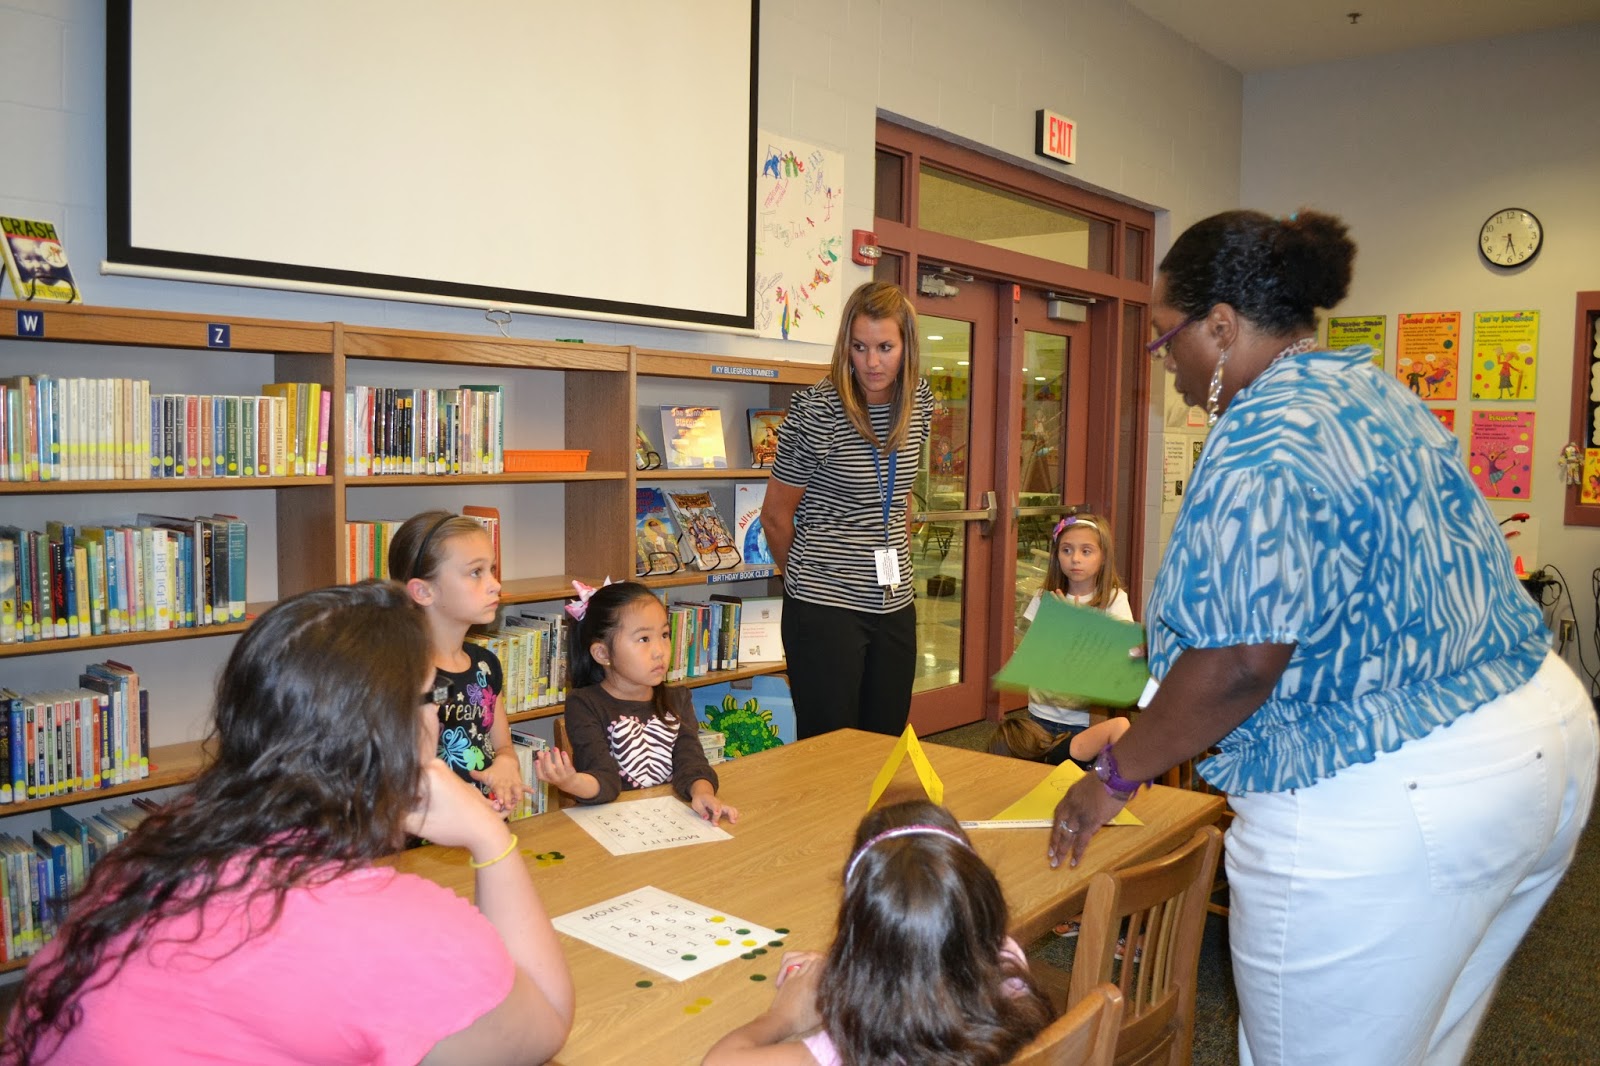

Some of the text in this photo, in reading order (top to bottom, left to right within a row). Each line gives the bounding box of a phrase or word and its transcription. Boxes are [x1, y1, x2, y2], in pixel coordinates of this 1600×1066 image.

[1050, 116, 1073, 158] EXIT
[1, 216, 58, 239] CRASH
[23, 315, 38, 332] W
[215, 329, 224, 343] Z
[724, 367, 752, 376] BLUEGRASS
[738, 509, 758, 529] All the
[712, 573, 739, 582] BIRTHDAY
[740, 571, 754, 579] BOOK
[444, 703, 488, 721] ream
[663, 834, 700, 844] MOVE
[582, 905, 621, 921] MOVE
